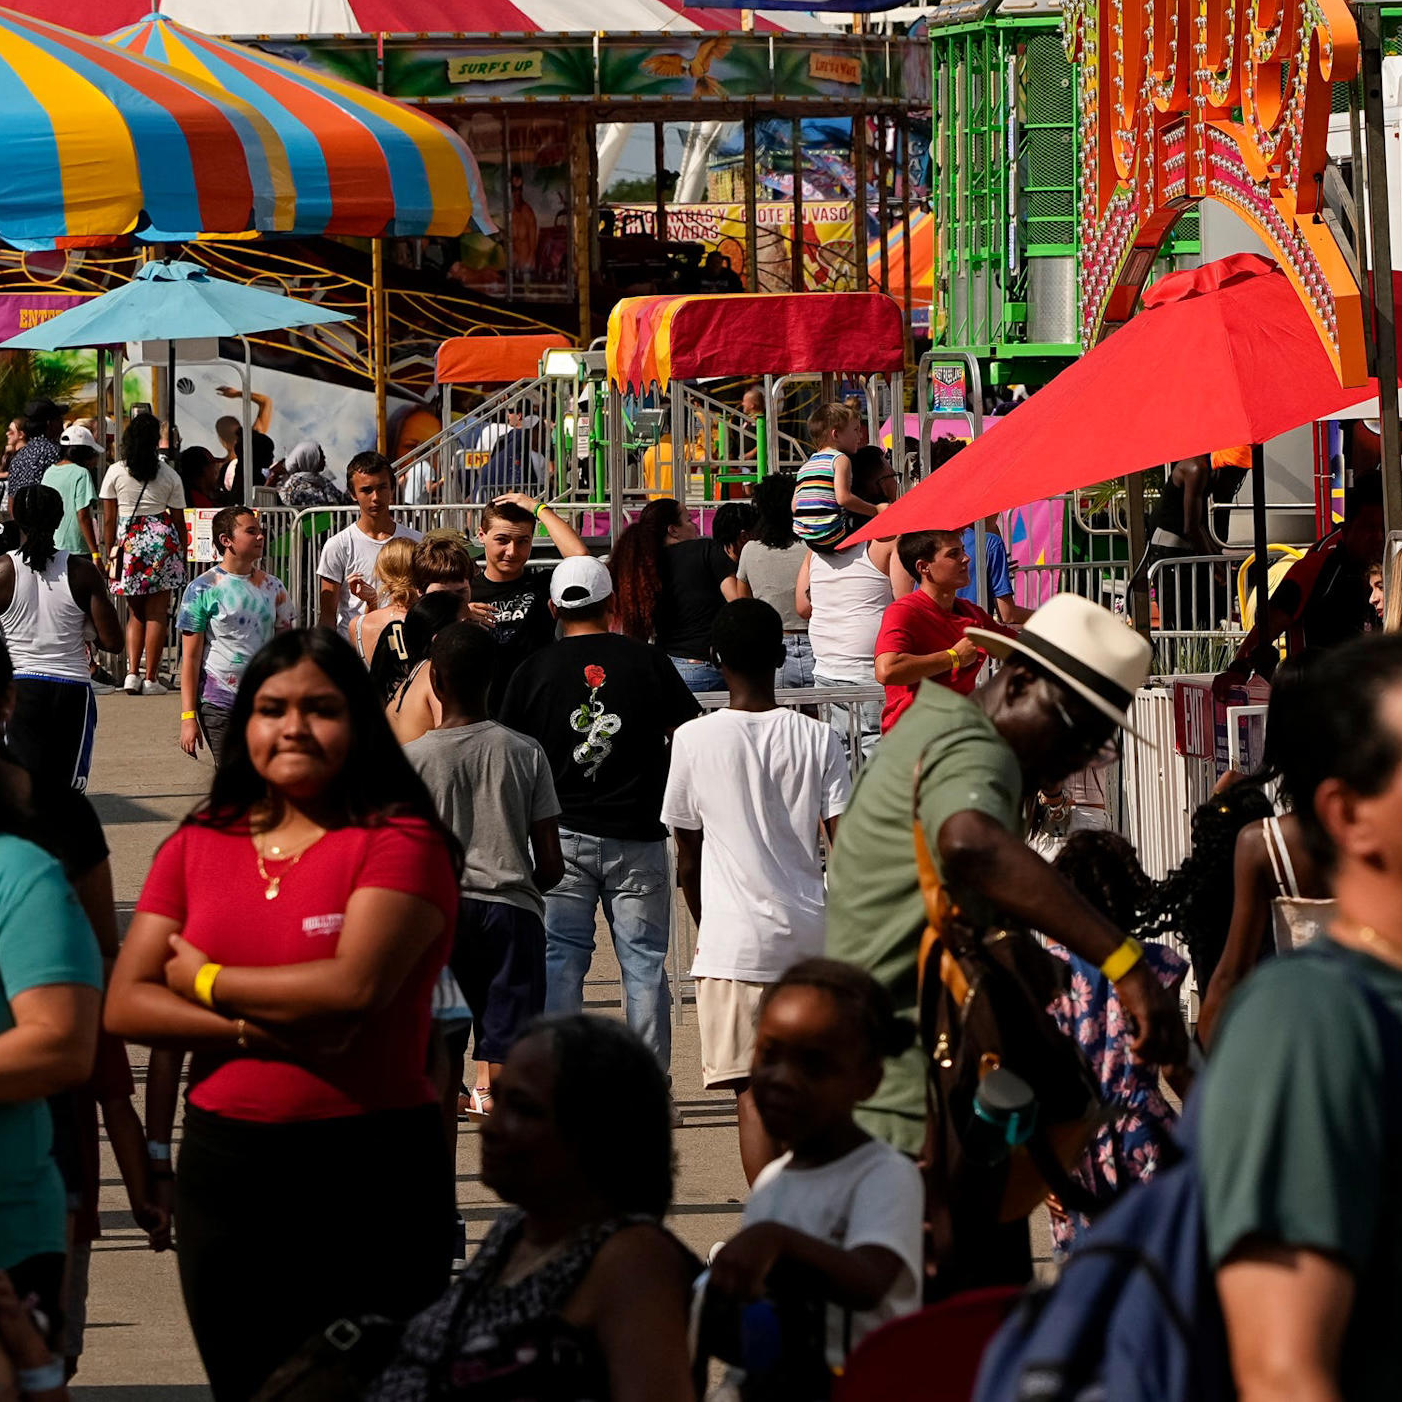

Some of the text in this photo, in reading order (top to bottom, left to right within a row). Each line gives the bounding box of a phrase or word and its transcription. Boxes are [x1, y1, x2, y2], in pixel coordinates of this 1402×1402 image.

[458, 60, 533, 75] SURF'S UP
[810, 206, 849, 223] VASO
[1183, 686, 1205, 756] EXIT
